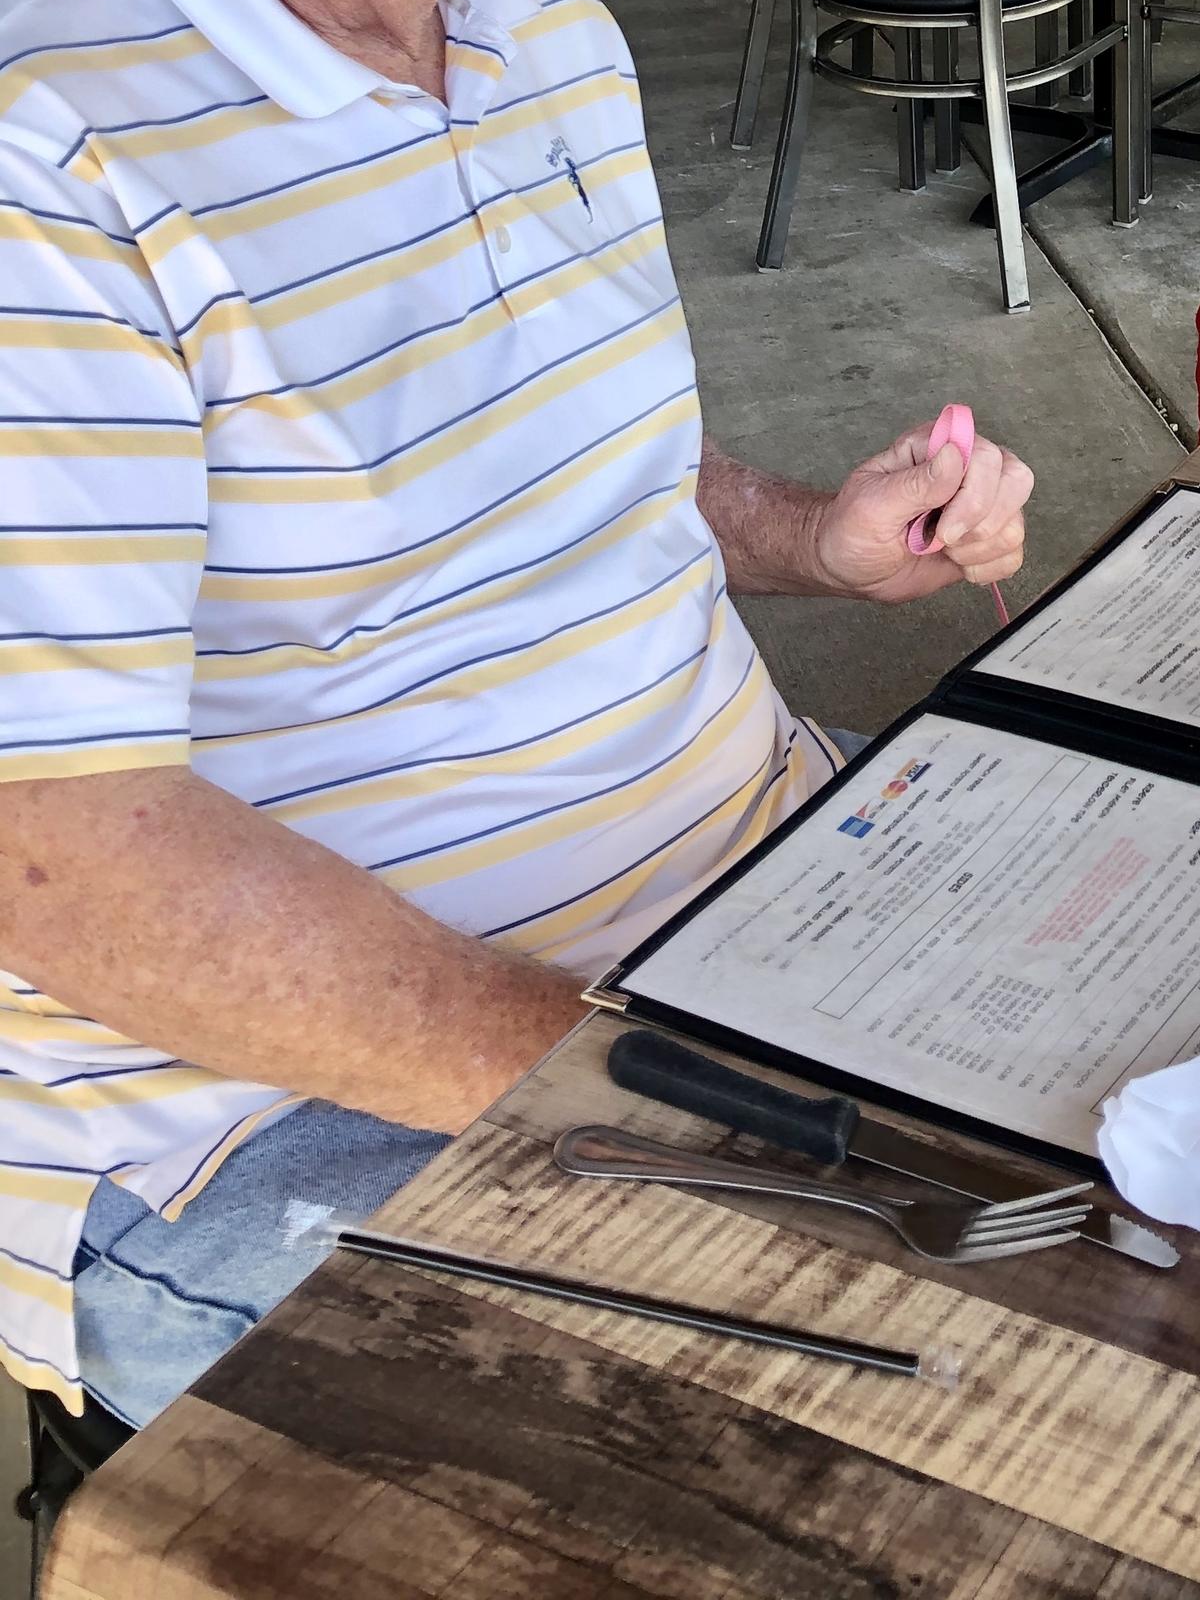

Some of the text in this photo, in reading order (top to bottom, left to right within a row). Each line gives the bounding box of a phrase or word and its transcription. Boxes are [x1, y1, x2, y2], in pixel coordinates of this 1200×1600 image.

[903, 763, 923, 778] VISA
[1068, 772, 1120, 823] TENDERLOIN TIPS
[1095, 777, 1137, 818] FILET MIGNON
[1129, 782, 1156, 805] RIBEYE
[946, 871, 974, 893] SIDES
